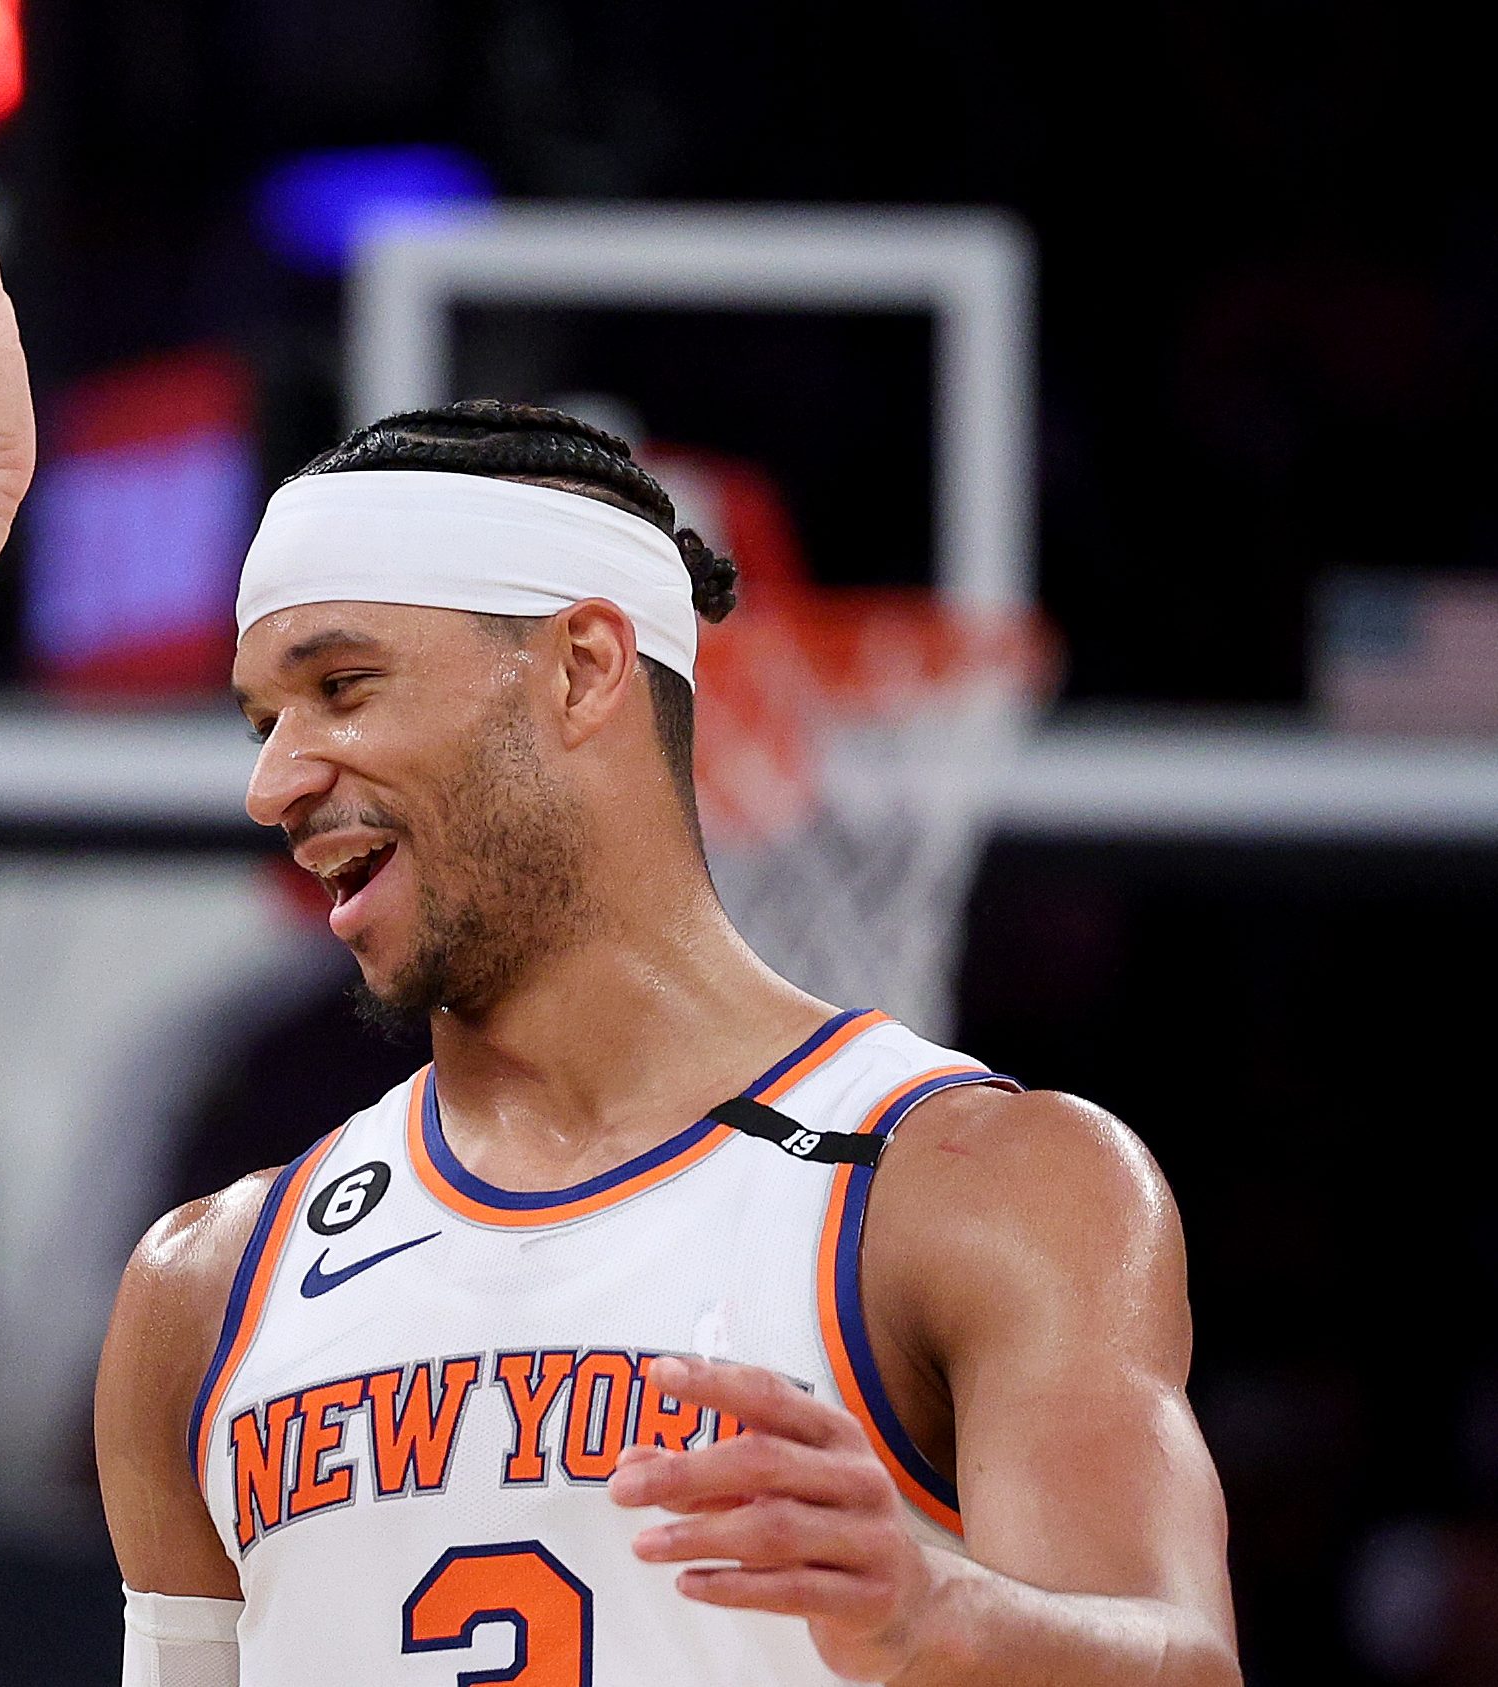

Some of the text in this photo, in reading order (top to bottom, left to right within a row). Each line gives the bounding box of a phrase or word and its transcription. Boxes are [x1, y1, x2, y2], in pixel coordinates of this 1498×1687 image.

[780, 1128, 822, 1157] 19
[321, 1168, 376, 1227] 6
[229, 1345, 814, 1560] NEW YOR
